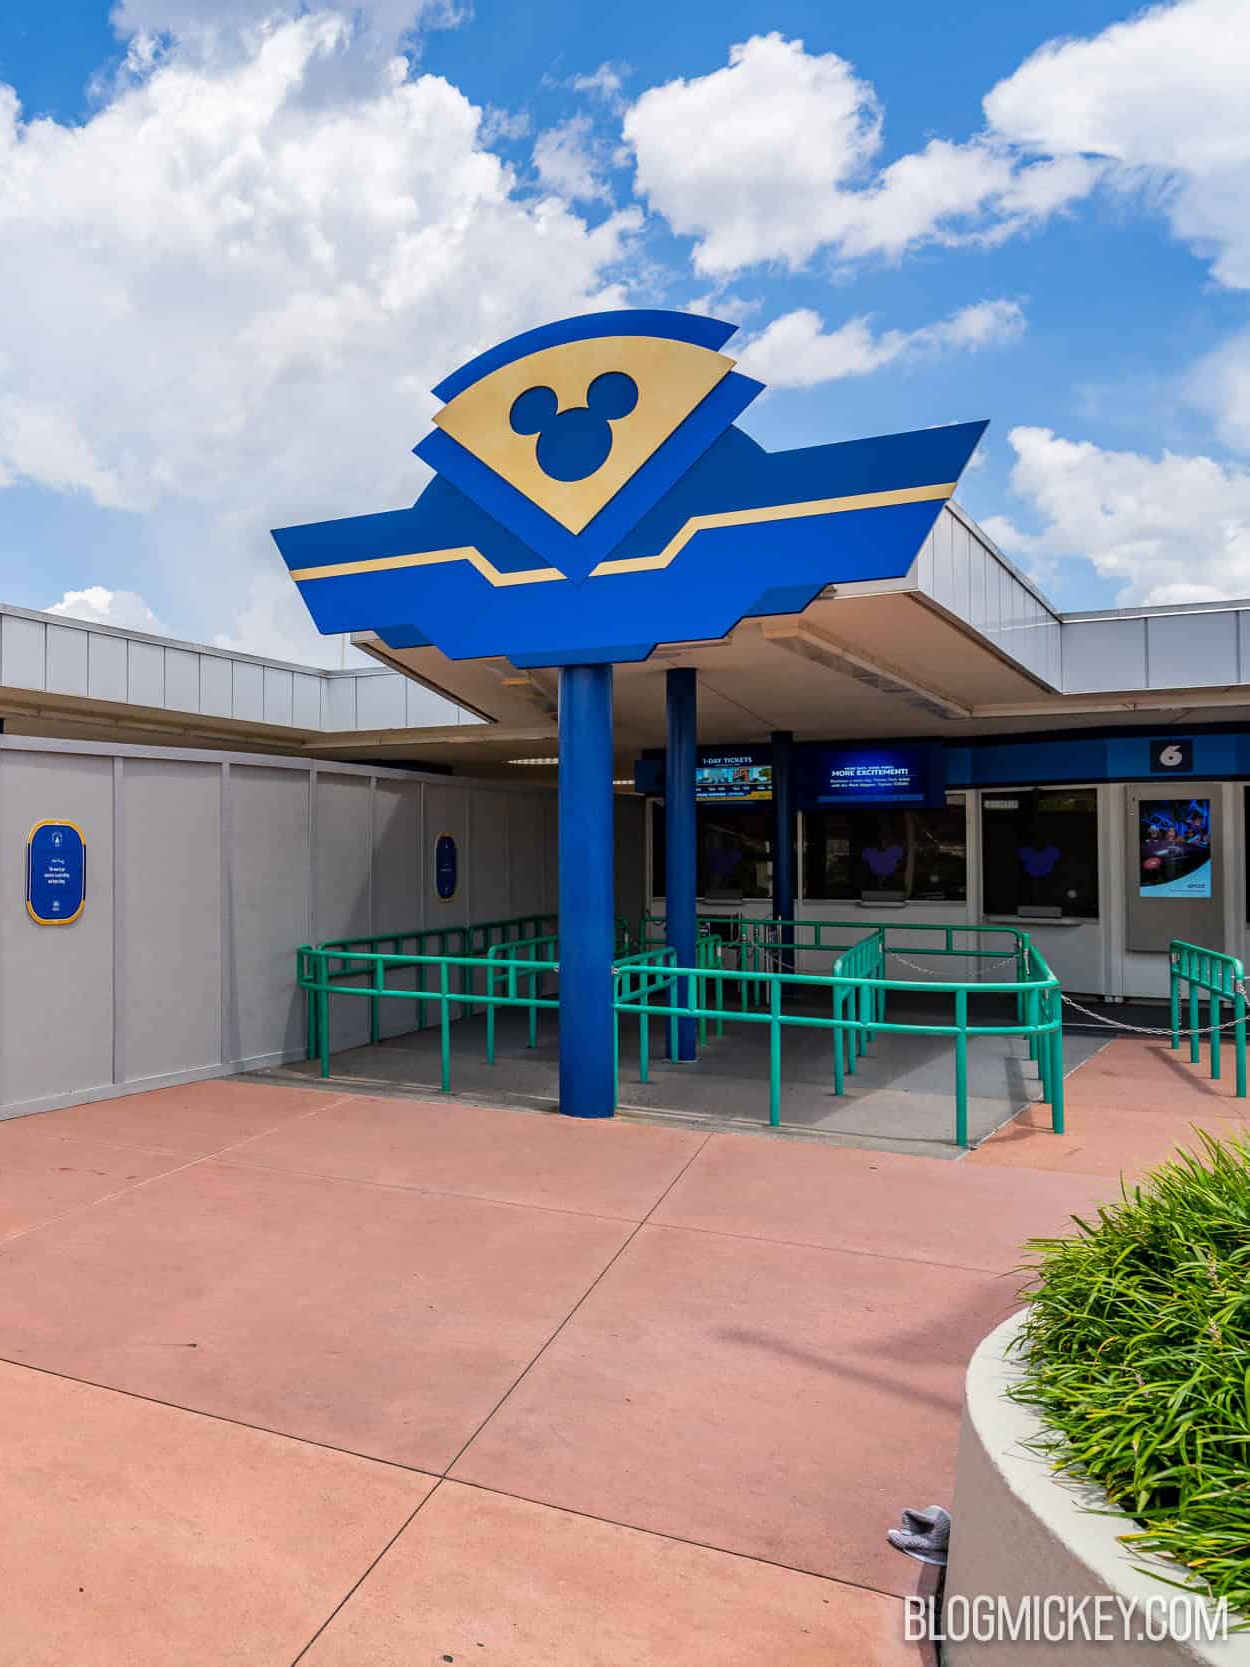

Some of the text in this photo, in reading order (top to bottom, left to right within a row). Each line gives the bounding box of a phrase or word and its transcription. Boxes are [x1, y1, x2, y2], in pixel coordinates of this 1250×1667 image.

[723, 756, 753, 764] TICKETS
[1159, 745, 1183, 767] 6
[831, 769, 855, 777] MORE
